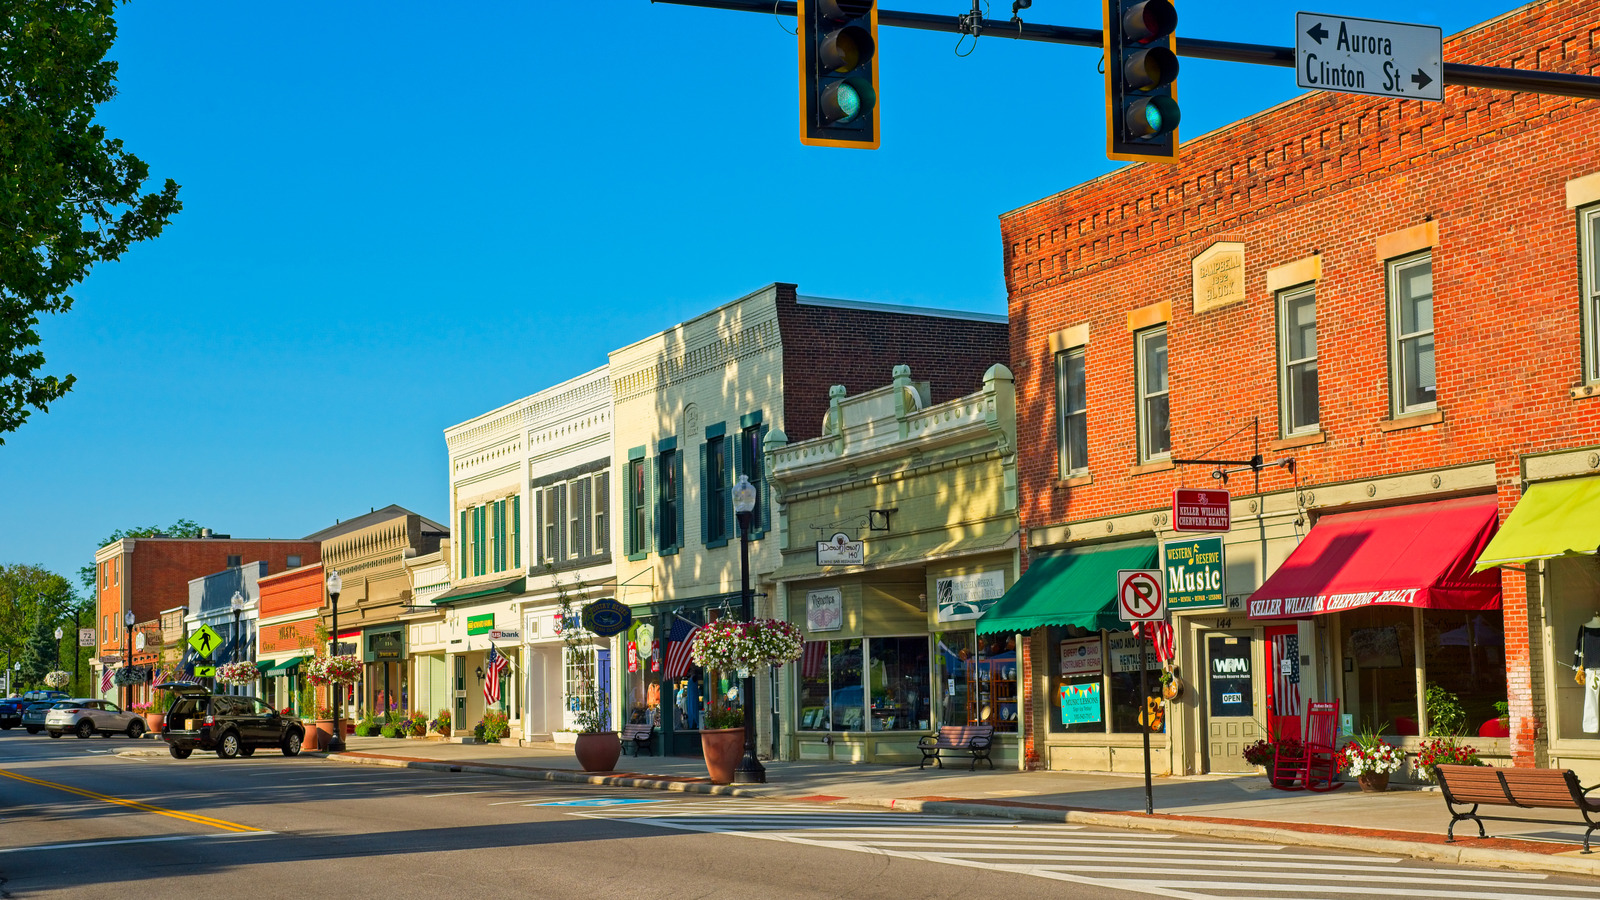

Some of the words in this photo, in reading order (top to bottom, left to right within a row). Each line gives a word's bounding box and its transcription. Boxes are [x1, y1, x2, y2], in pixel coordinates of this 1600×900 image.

[1337, 21, 1392, 56] Aurora
[1306, 53, 1365, 89] Clinton
[1382, 61, 1404, 93] St.
[1200, 255, 1241, 279] CAMPBELL
[1207, 281, 1235, 301] BLOCK
[1179, 506, 1200, 516] KELLER
[1179, 517, 1208, 526] CHERVENIC
[1208, 517, 1229, 527] REALTY
[1167, 547, 1193, 560] WESTERN
[1195, 552, 1220, 565] RESERVE
[1168, 564, 1221, 594] Music
[1133, 581, 1153, 609] P
[1250, 599, 1281, 617] KELLER
[1327, 592, 1379, 610] CHERVENIC
[1375, 588, 1421, 604] REALTY
[1216, 618, 1232, 629] 144
[1110, 638, 1124, 650] BAND
[1125, 637, 1136, 648] AND
[1063, 648, 1078, 658] EXPERT
[1087, 646, 1099, 656] BAND
[1087, 658, 1101, 668] REPAIR
[1065, 698, 1080, 706] MUSIC
[1080, 696, 1099, 705] LESSONS
[1223, 694, 1241, 702] OPEN
